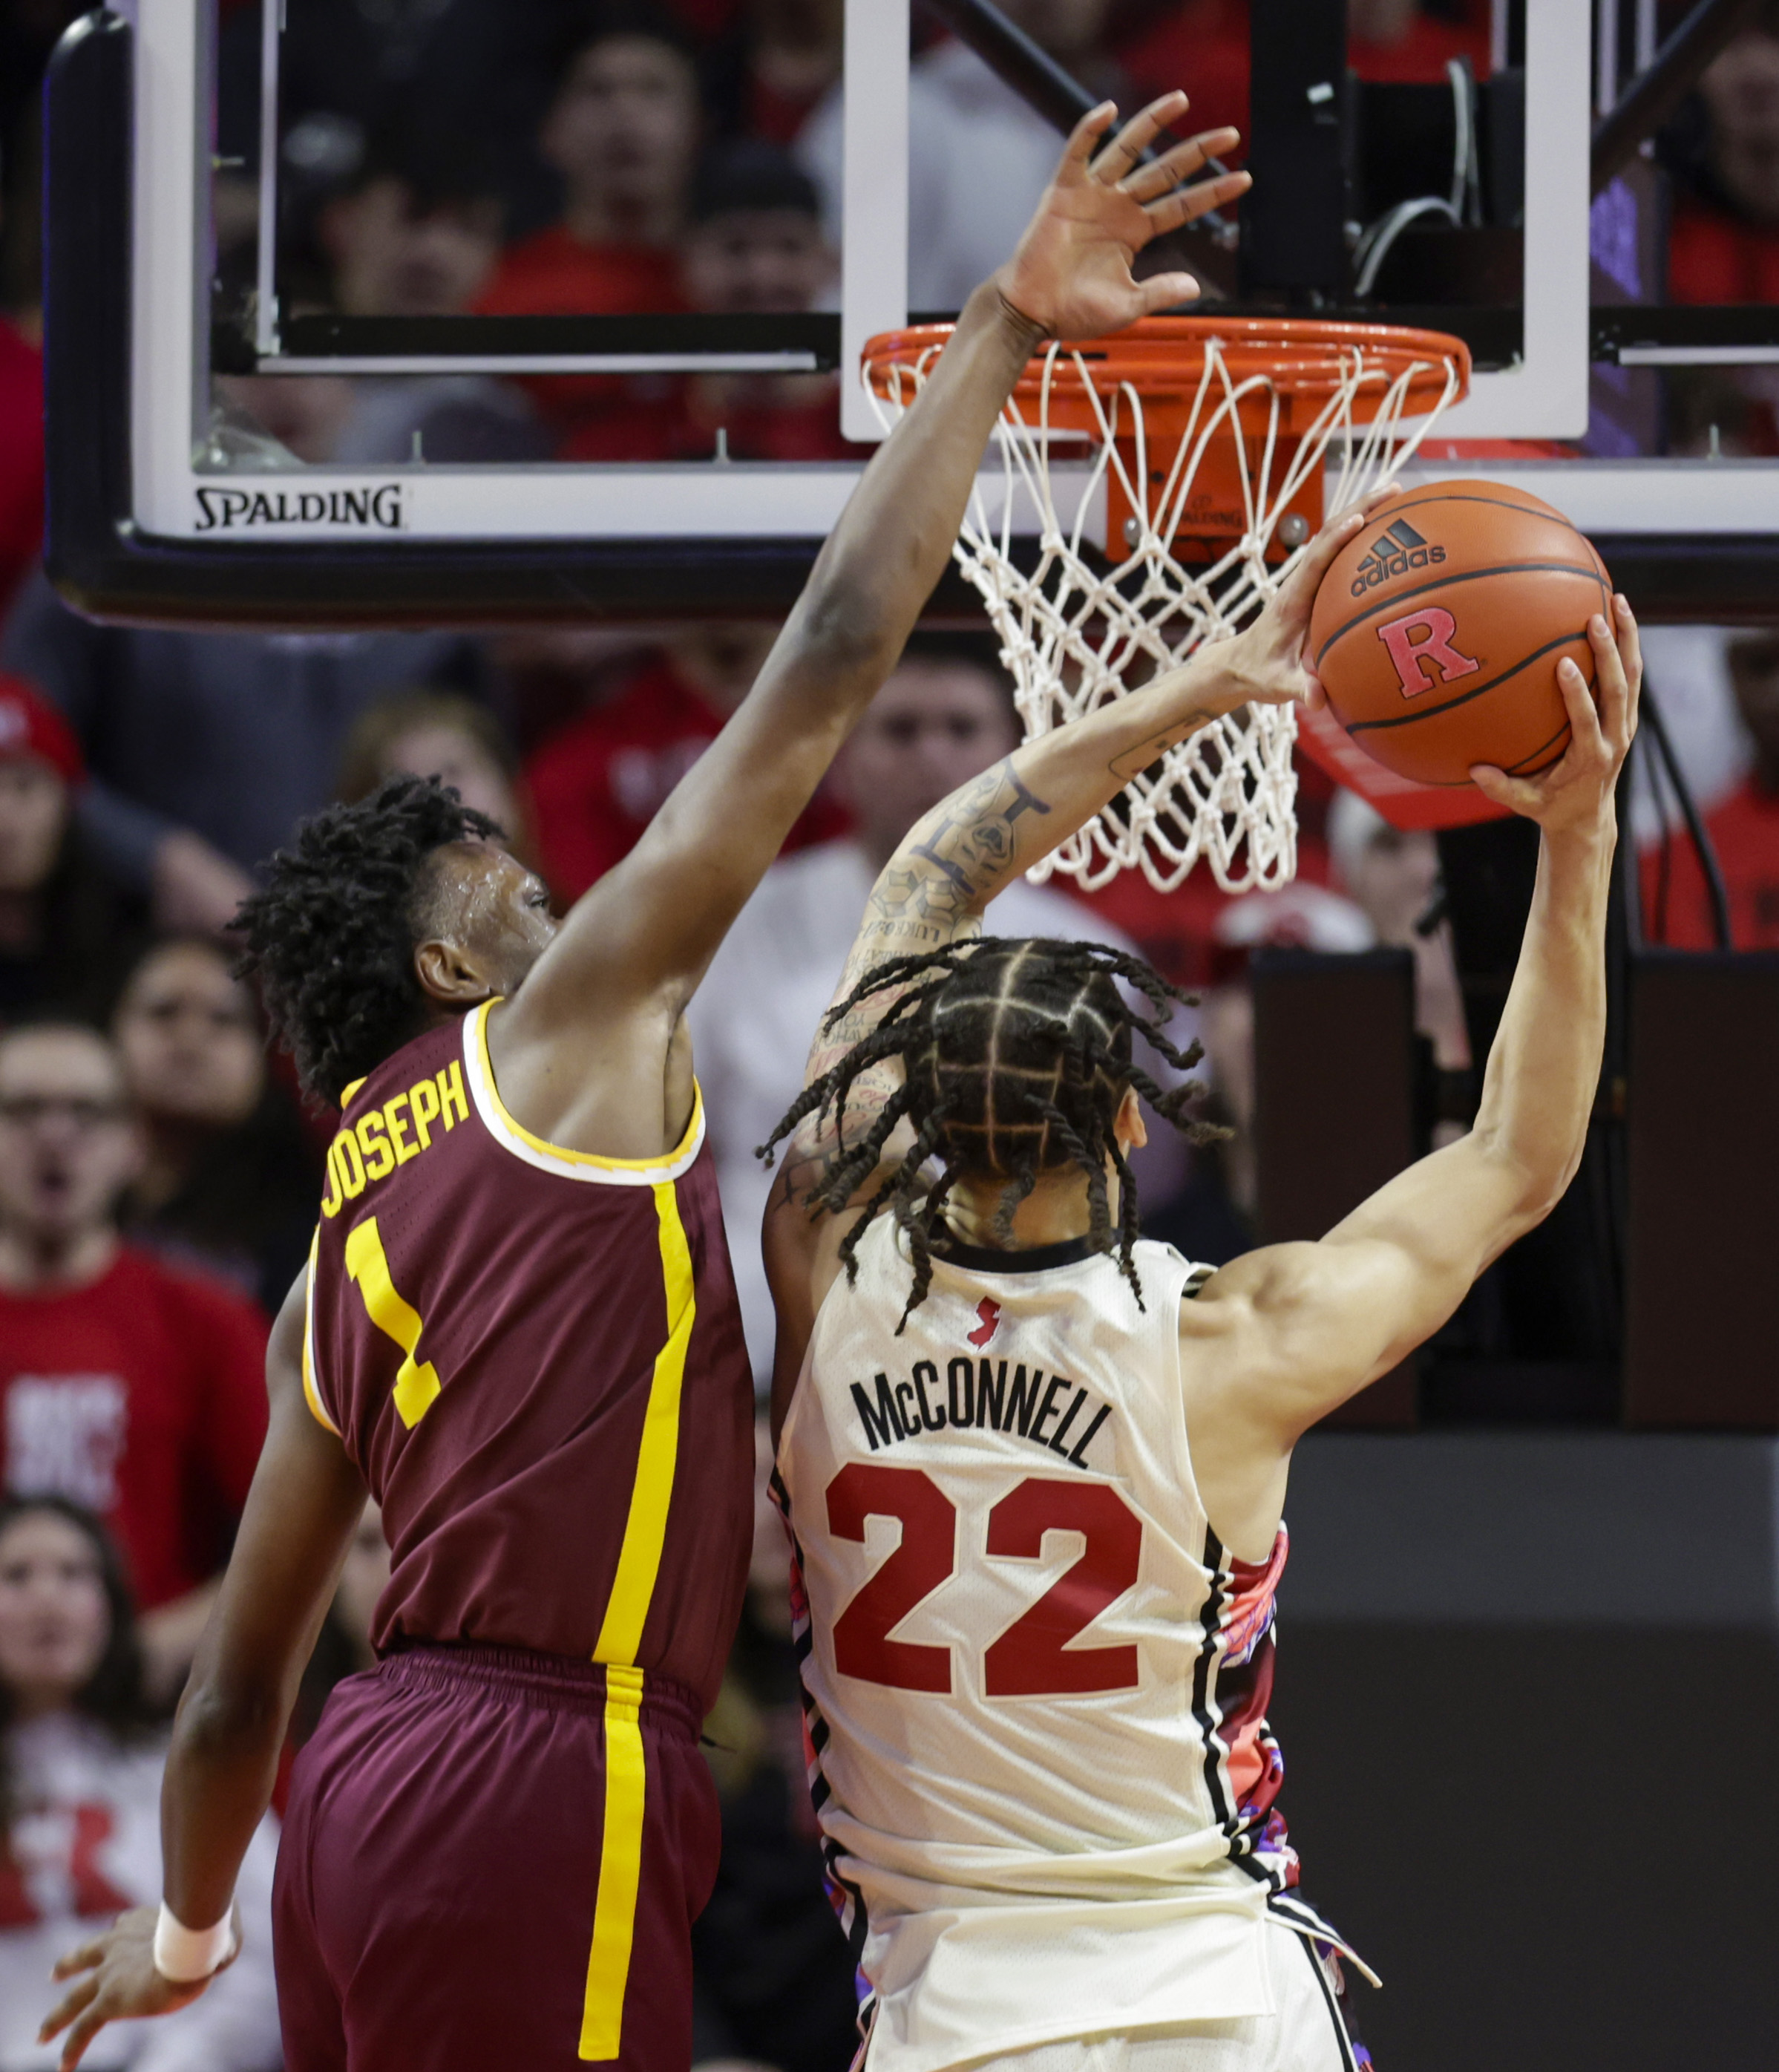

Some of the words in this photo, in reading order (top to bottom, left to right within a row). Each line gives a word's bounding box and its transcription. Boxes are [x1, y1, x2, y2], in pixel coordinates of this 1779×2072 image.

[196, 484, 402, 531] SPALDING
[1351, 546, 1447, 597] adidas
[1376, 607, 1480, 699] R
[321, 1059, 470, 1219] JOSEPH
[345, 1216, 441, 1430] 1
[850, 1357, 1113, 1470] McCONNELL
[825, 1462, 1144, 1696] 22
